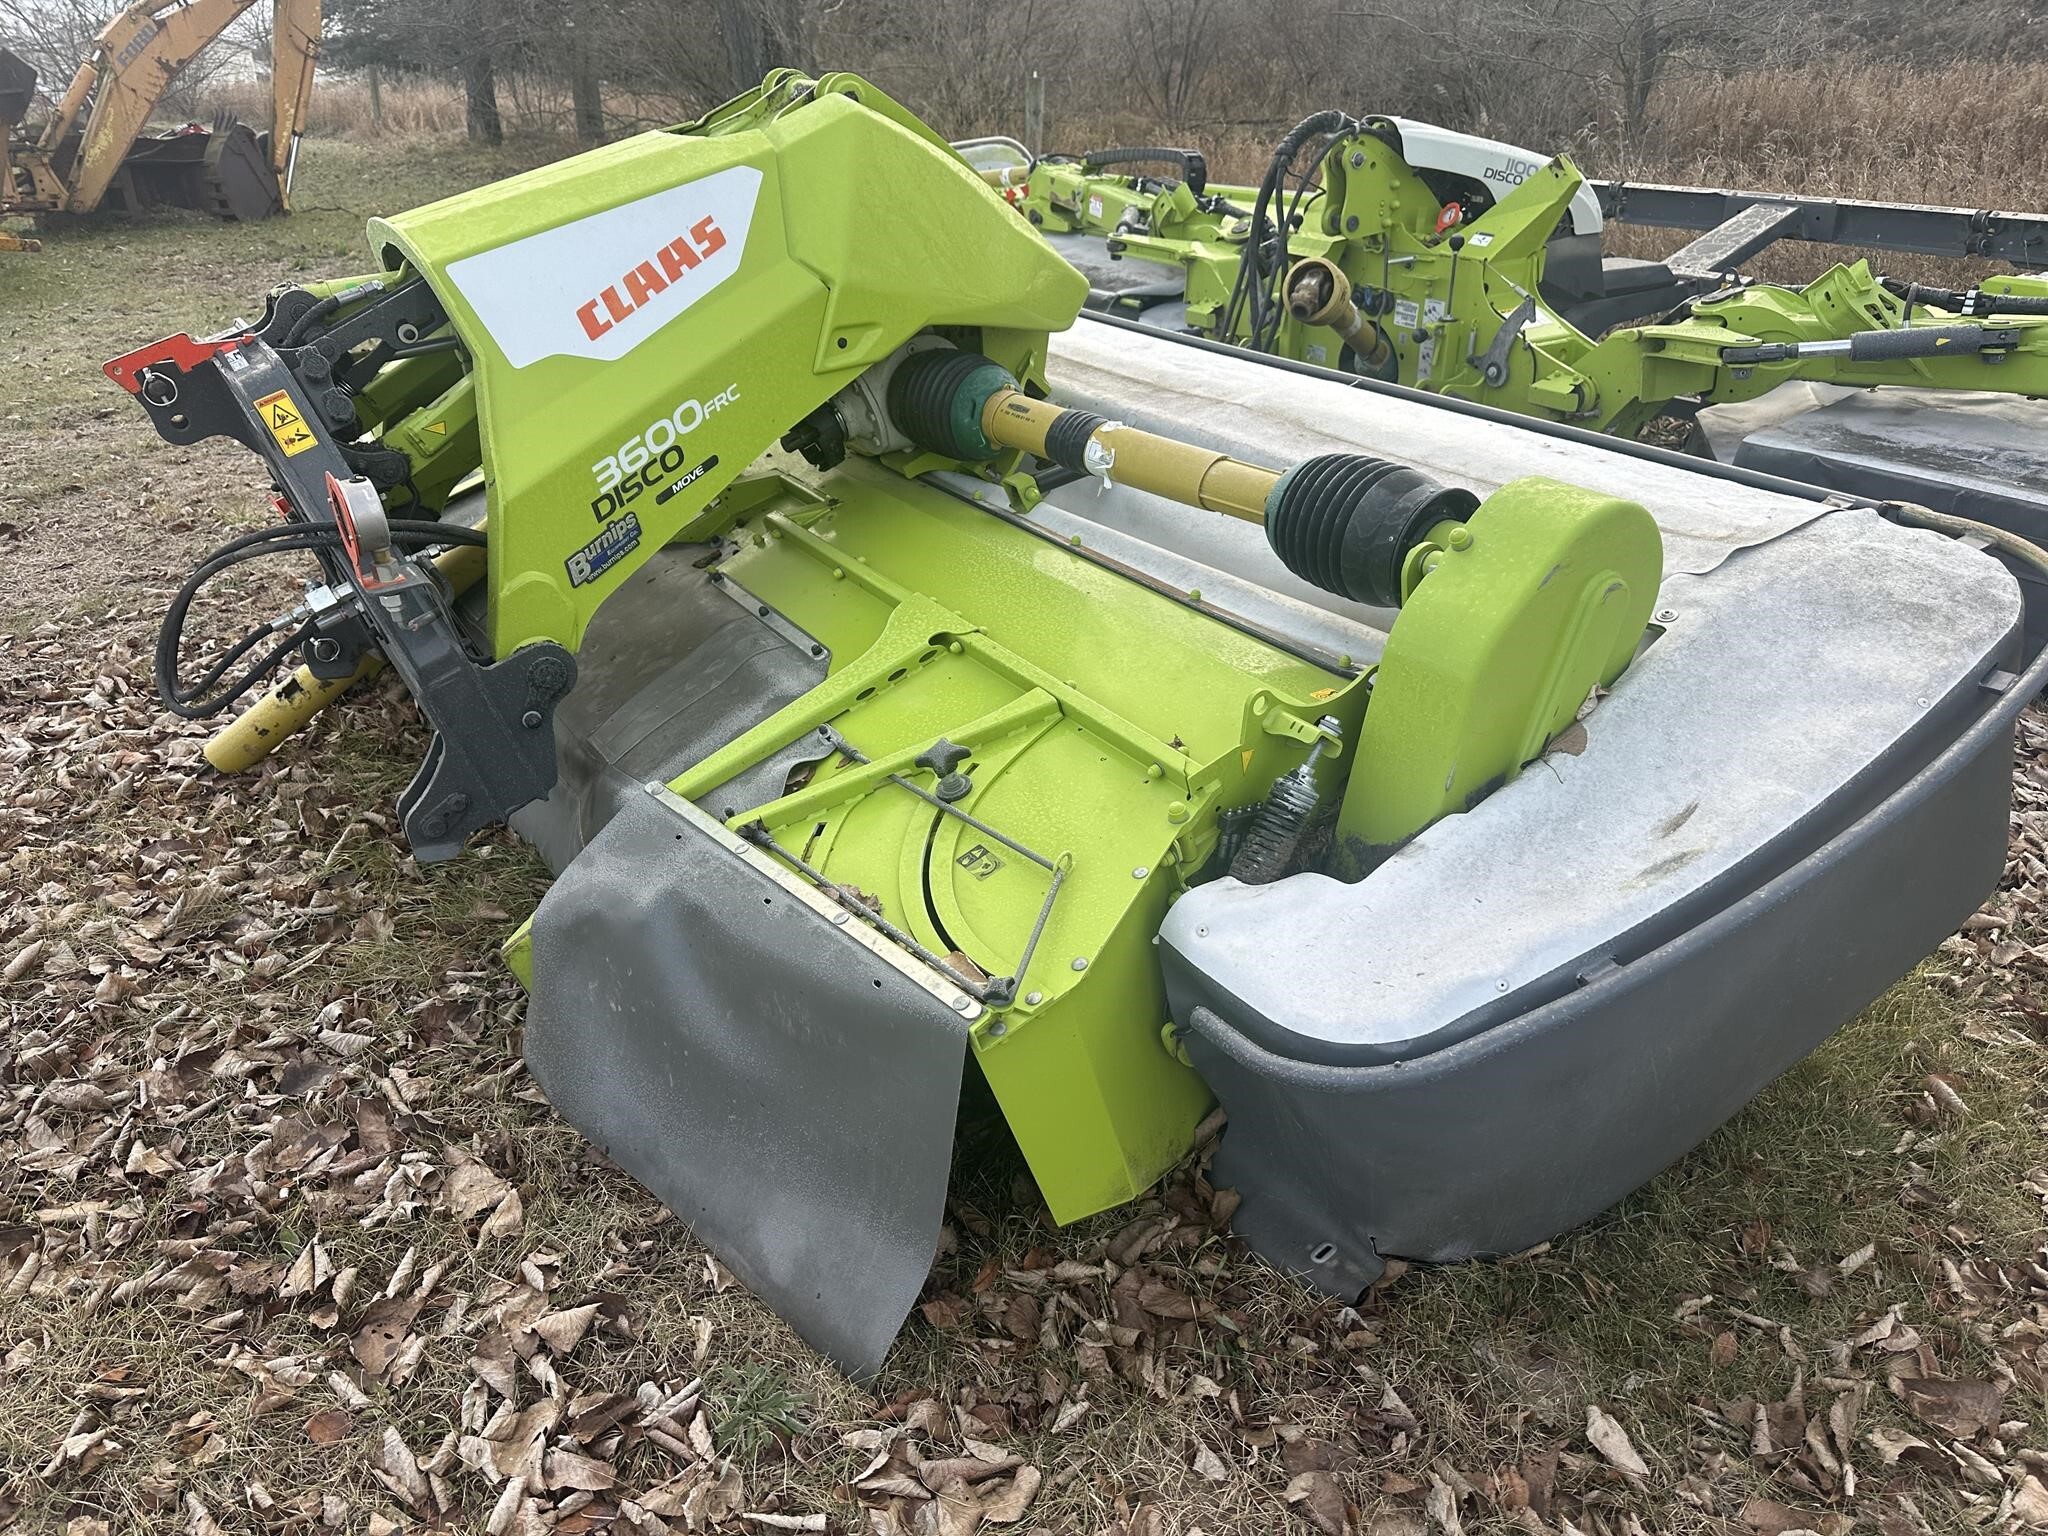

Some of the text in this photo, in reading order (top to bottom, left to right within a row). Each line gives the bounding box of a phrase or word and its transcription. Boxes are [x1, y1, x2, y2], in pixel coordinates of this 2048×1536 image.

[1484, 167, 1524, 185] DISCO
[1505, 158, 1539, 177] 1100
[576, 214, 726, 342] CLAAS
[591, 445, 684, 524] DISCO
[672, 465, 705, 494] MOVE
[568, 513, 637, 586] Burnips
